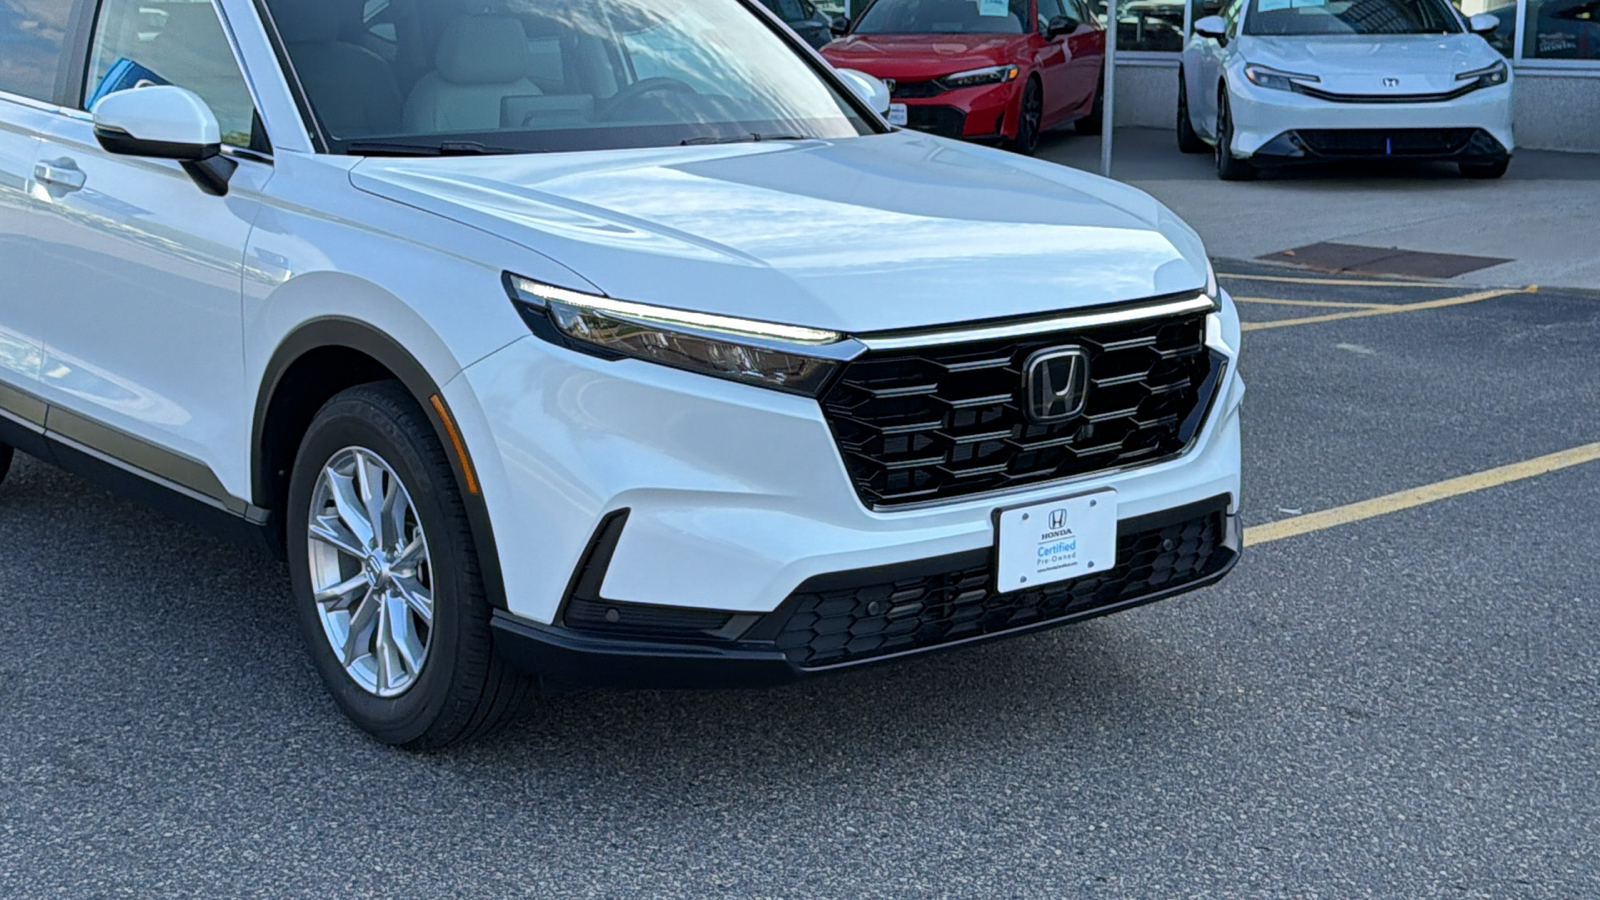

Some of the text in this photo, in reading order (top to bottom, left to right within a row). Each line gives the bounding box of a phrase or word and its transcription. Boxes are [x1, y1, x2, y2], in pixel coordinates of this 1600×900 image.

[1041, 528, 1072, 540] HONDA
[1037, 539, 1076, 557] Certified
[1036, 551, 1076, 565] Pre-Owned
